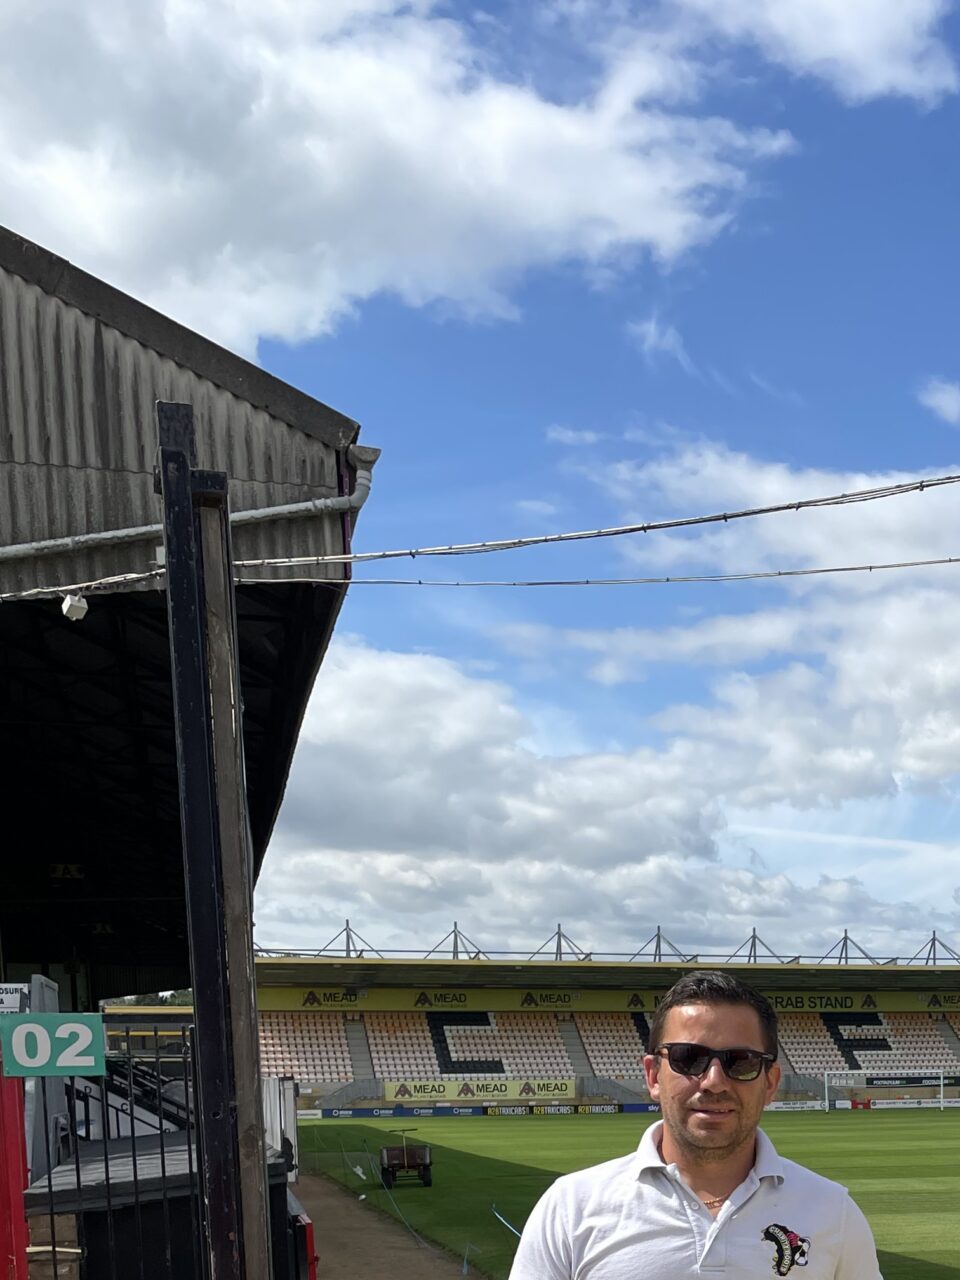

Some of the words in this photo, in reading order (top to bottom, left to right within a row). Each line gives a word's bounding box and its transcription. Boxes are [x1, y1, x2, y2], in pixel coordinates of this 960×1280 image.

[323, 992, 358, 1003] MEAD
[434, 993, 467, 1003] MEAD
[539, 994, 571, 1004] MEAD
[808, 996, 854, 1009] STAND
[12, 1023, 95, 1068] 02
[414, 1084, 446, 1094] MEAD
[476, 1084, 508, 1093] MEAD
[537, 1083, 568, 1092] MEAD
